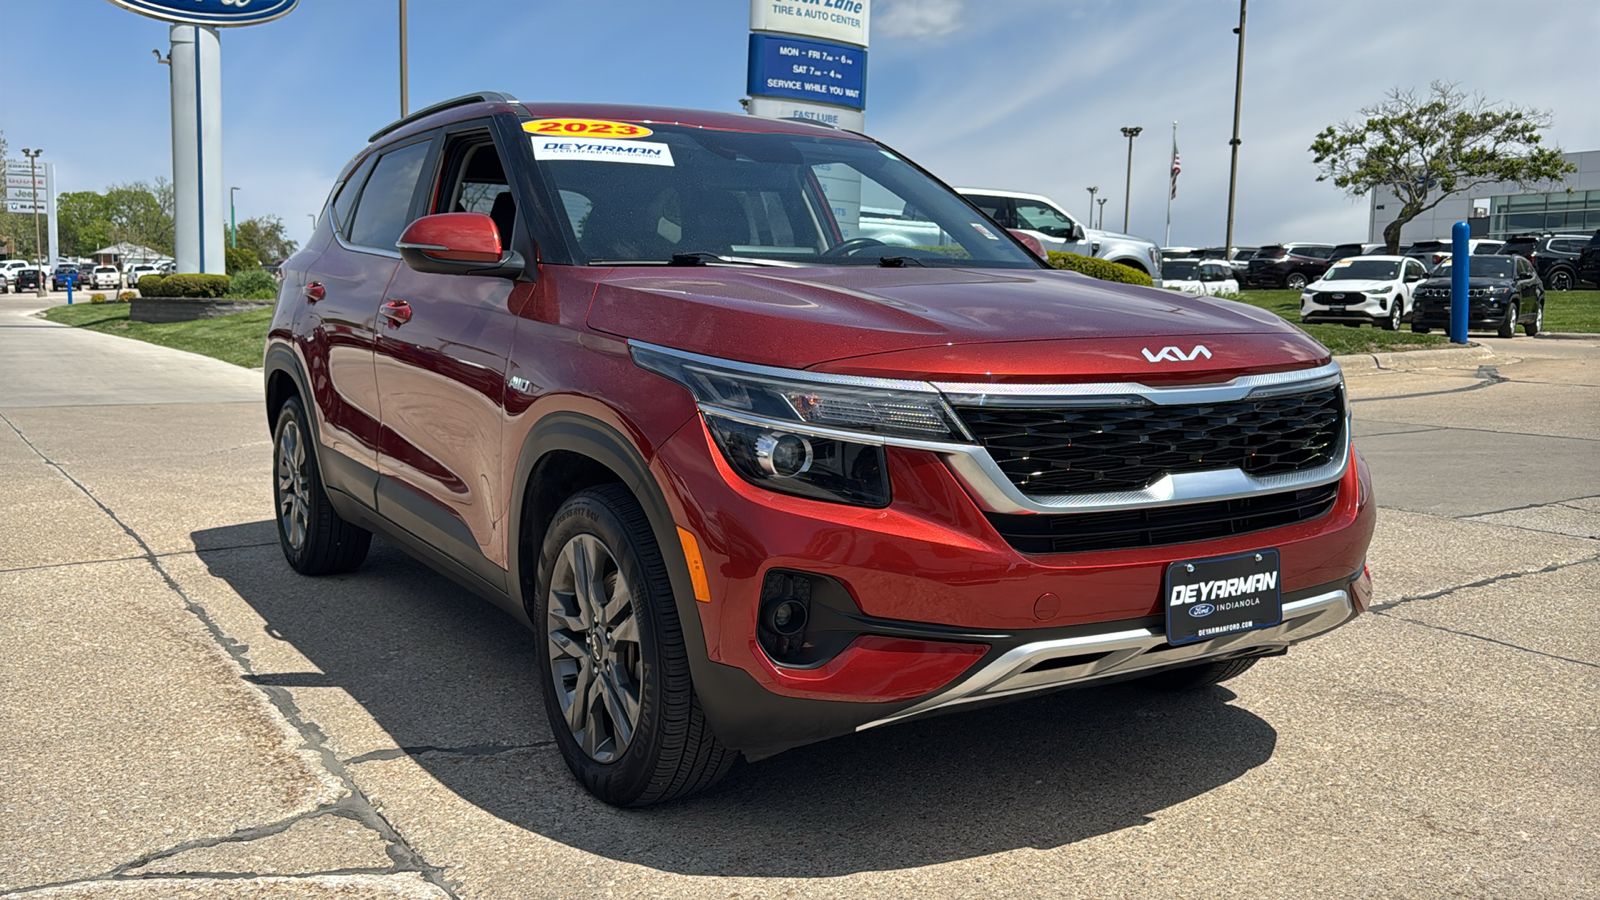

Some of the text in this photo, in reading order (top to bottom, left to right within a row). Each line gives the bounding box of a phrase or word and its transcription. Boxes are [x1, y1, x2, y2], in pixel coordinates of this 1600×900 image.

[773, 5, 861, 28] TIRE & AUTO CENTER
[780, 46, 799, 56] MON
[808, 50, 820, 59] FRI
[793, 65, 807, 74] SAT
[767, 79, 860, 98] SERVICE WHILE YOU WAIT
[816, 112, 839, 123] LUBE
[536, 122, 640, 135] 2023
[543, 143, 662, 155] DEYARMAN
[1141, 345, 1213, 363] KIA
[1170, 571, 1277, 606] DEYARMAN
[1193, 597, 1260, 615] Ford INDIANOLA
[1198, 621, 1253, 637] DEYARMANFORD.COM
